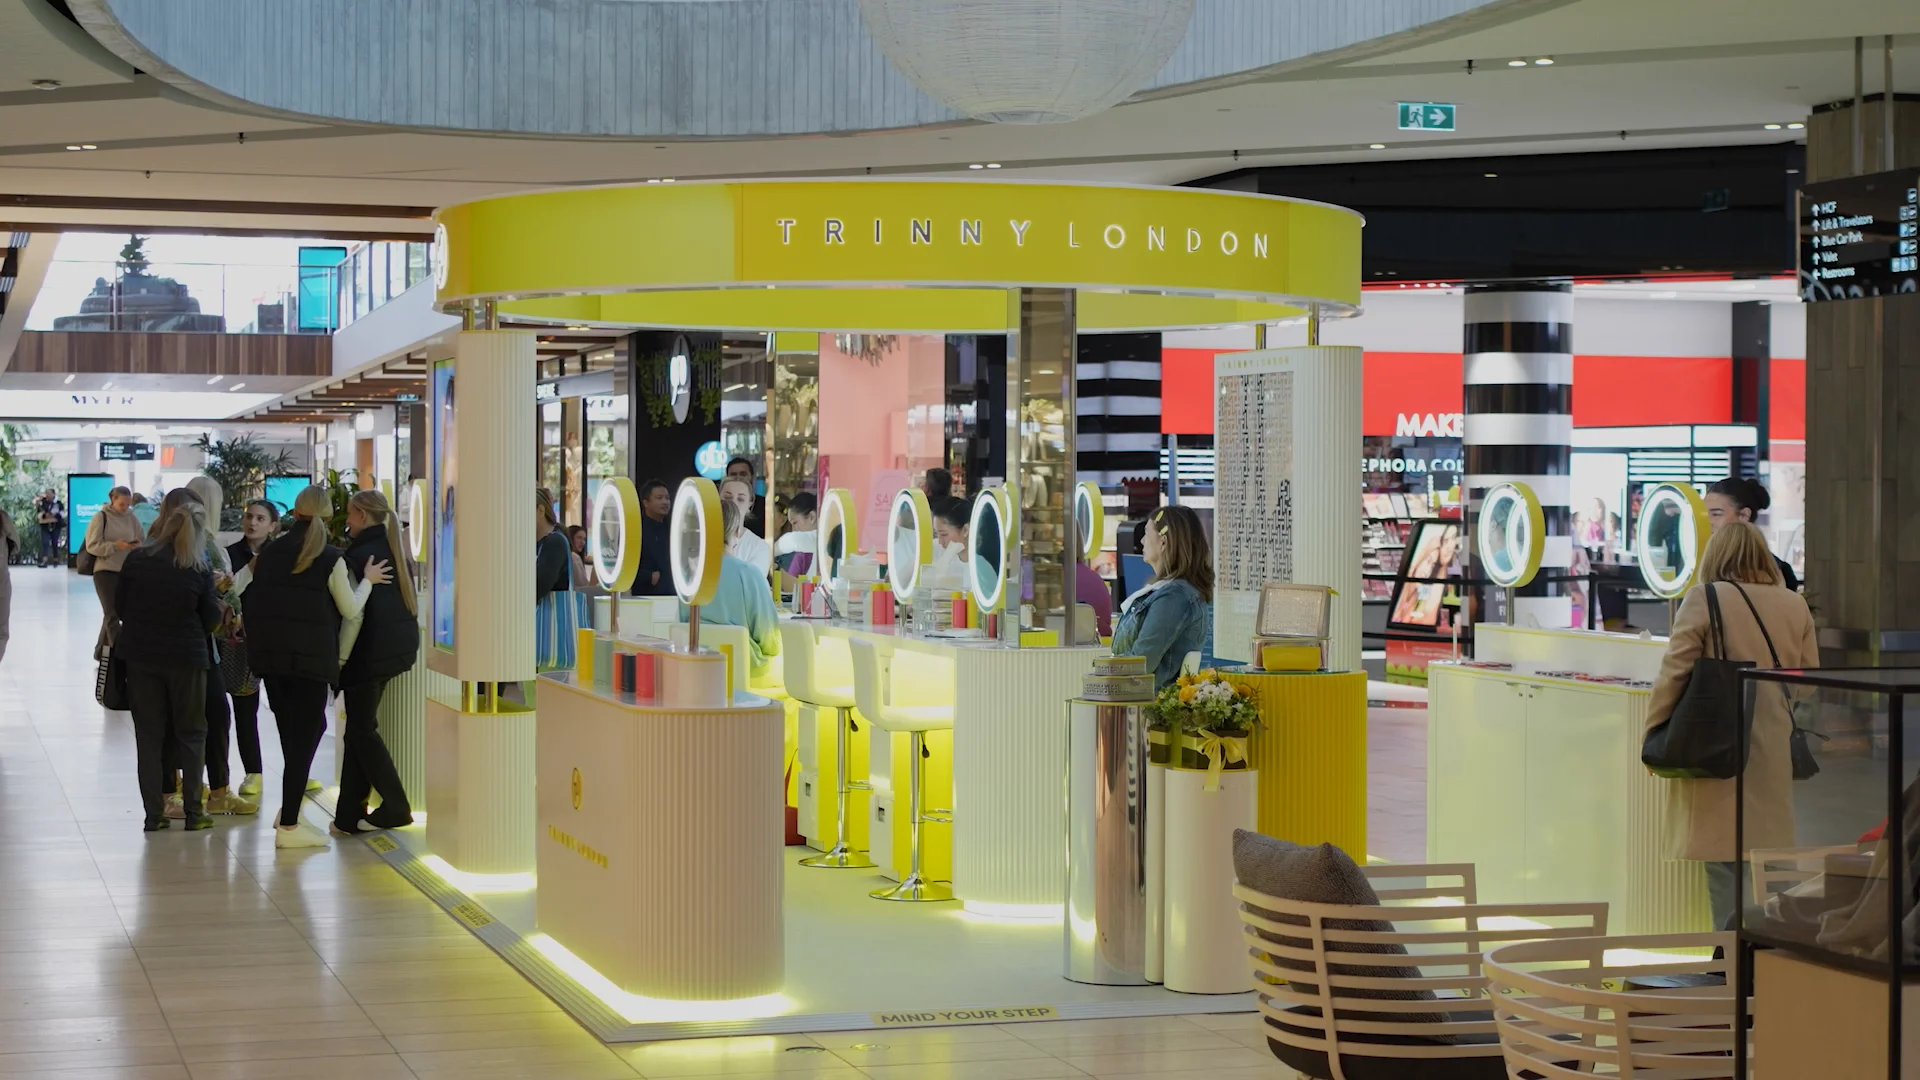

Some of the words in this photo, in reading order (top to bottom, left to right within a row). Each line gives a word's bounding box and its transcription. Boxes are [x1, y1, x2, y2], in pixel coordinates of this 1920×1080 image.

[777, 218, 1031, 246] TRINNY
[1069, 222, 1269, 259] LONDON
[1821, 267, 1856, 279] Restrooms
[1361, 458, 1427, 472] EPHORA
[1430, 458, 1464, 473] COL
[881, 1012, 936, 1024] MIND
[939, 1010, 998, 1021] YOUR
[1001, 1007, 1050, 1019] STEP
